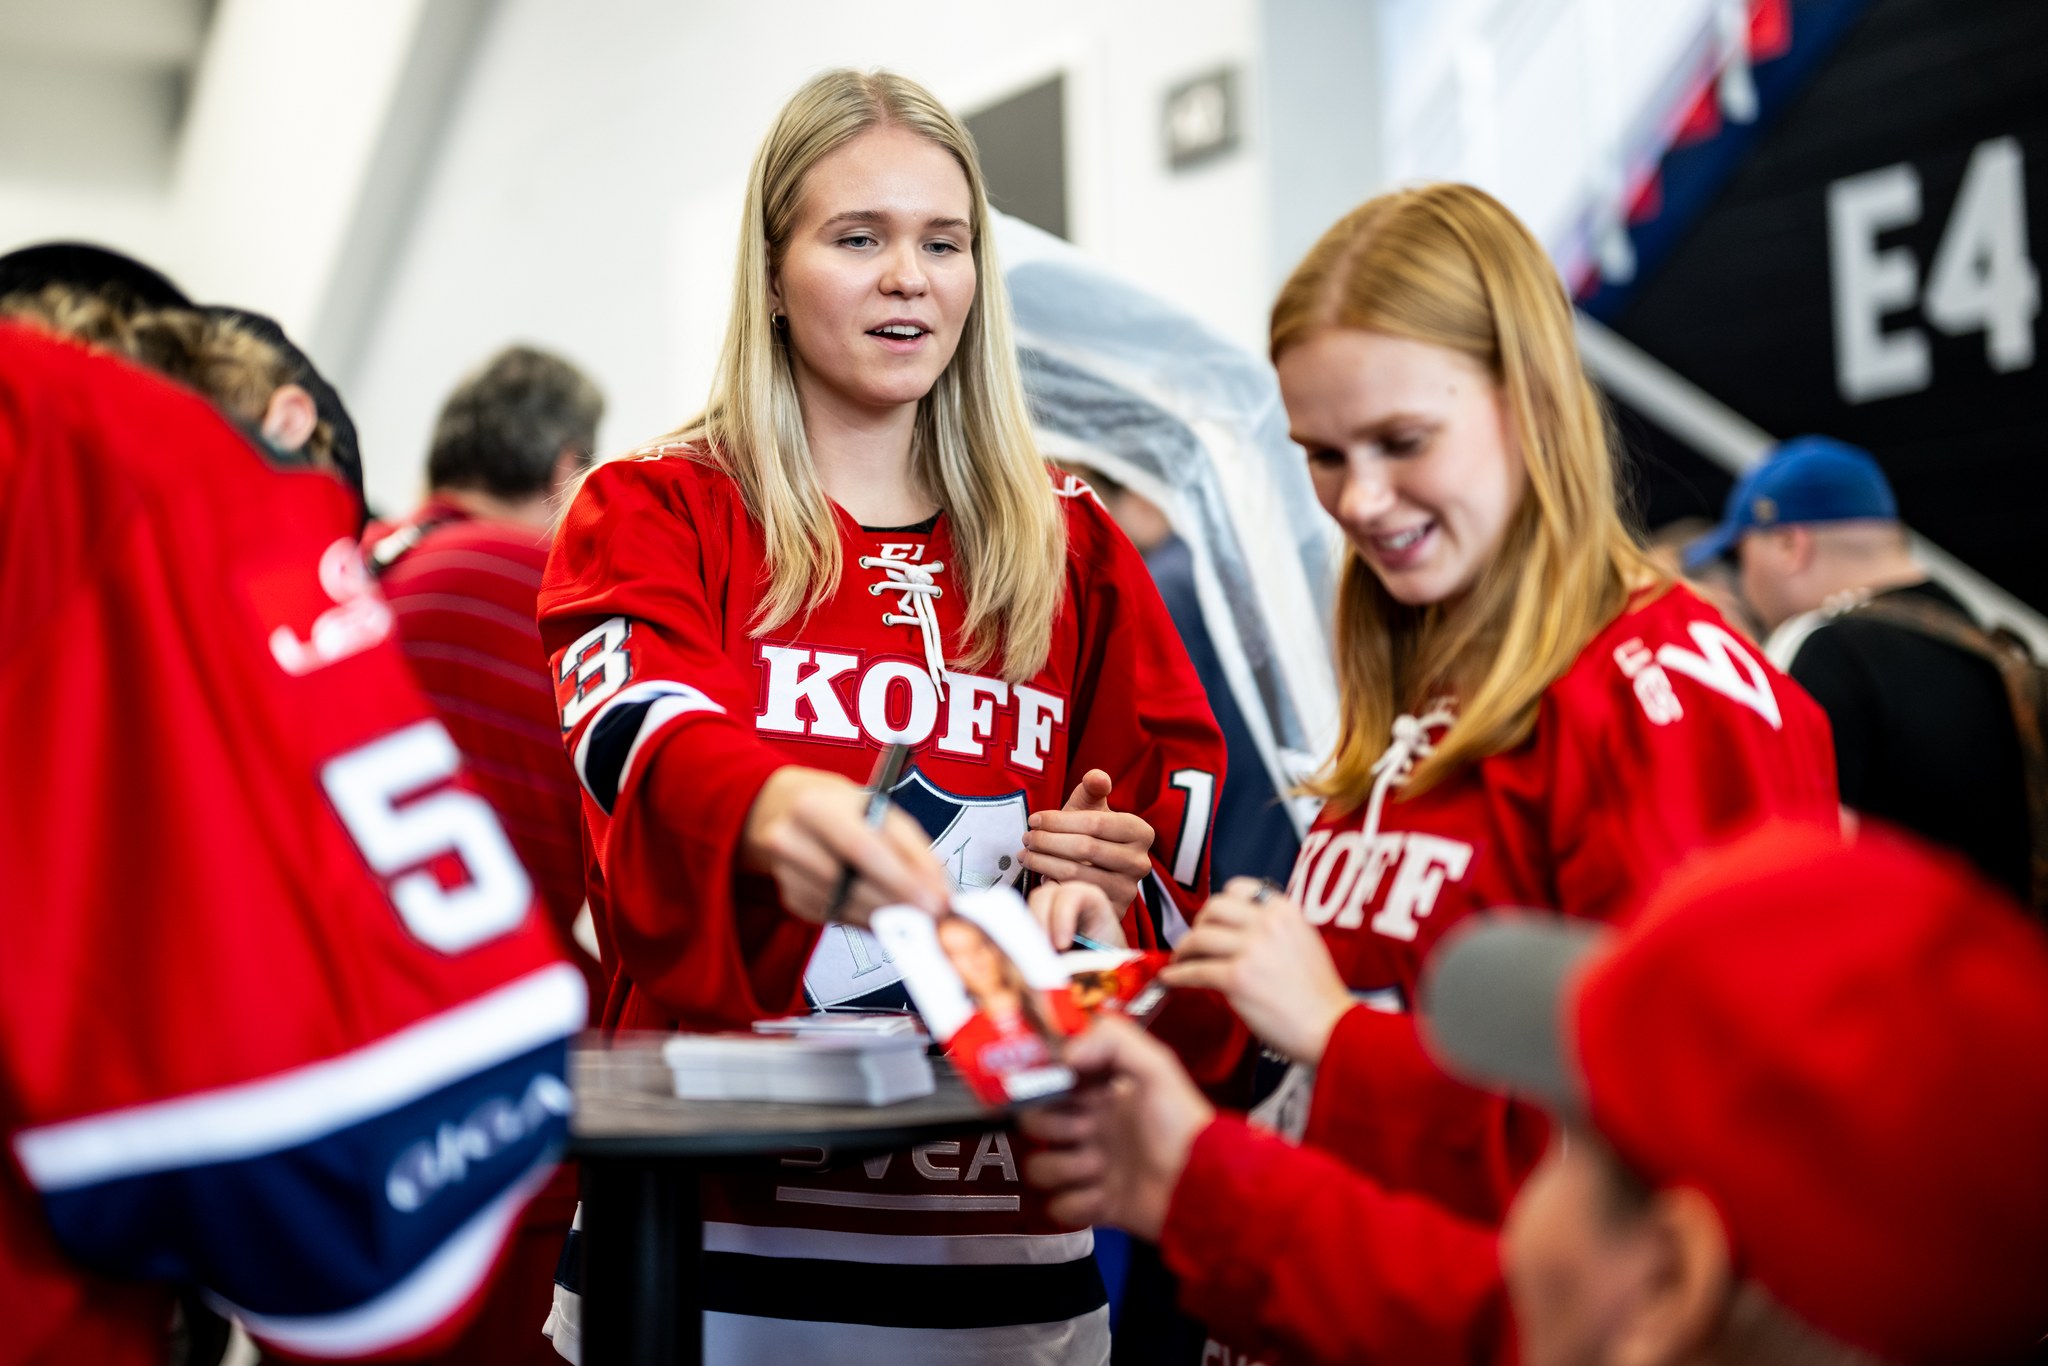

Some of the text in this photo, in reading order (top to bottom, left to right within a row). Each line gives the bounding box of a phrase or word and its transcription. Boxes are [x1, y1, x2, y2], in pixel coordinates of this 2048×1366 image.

[1827, 134, 2041, 404] E4
[559, 616, 633, 733] 3
[755, 644, 1065, 773] KOFF
[320, 719, 535, 956] 5
[1169, 768, 1215, 892] 1
[1285, 828, 1475, 942] KOFF
